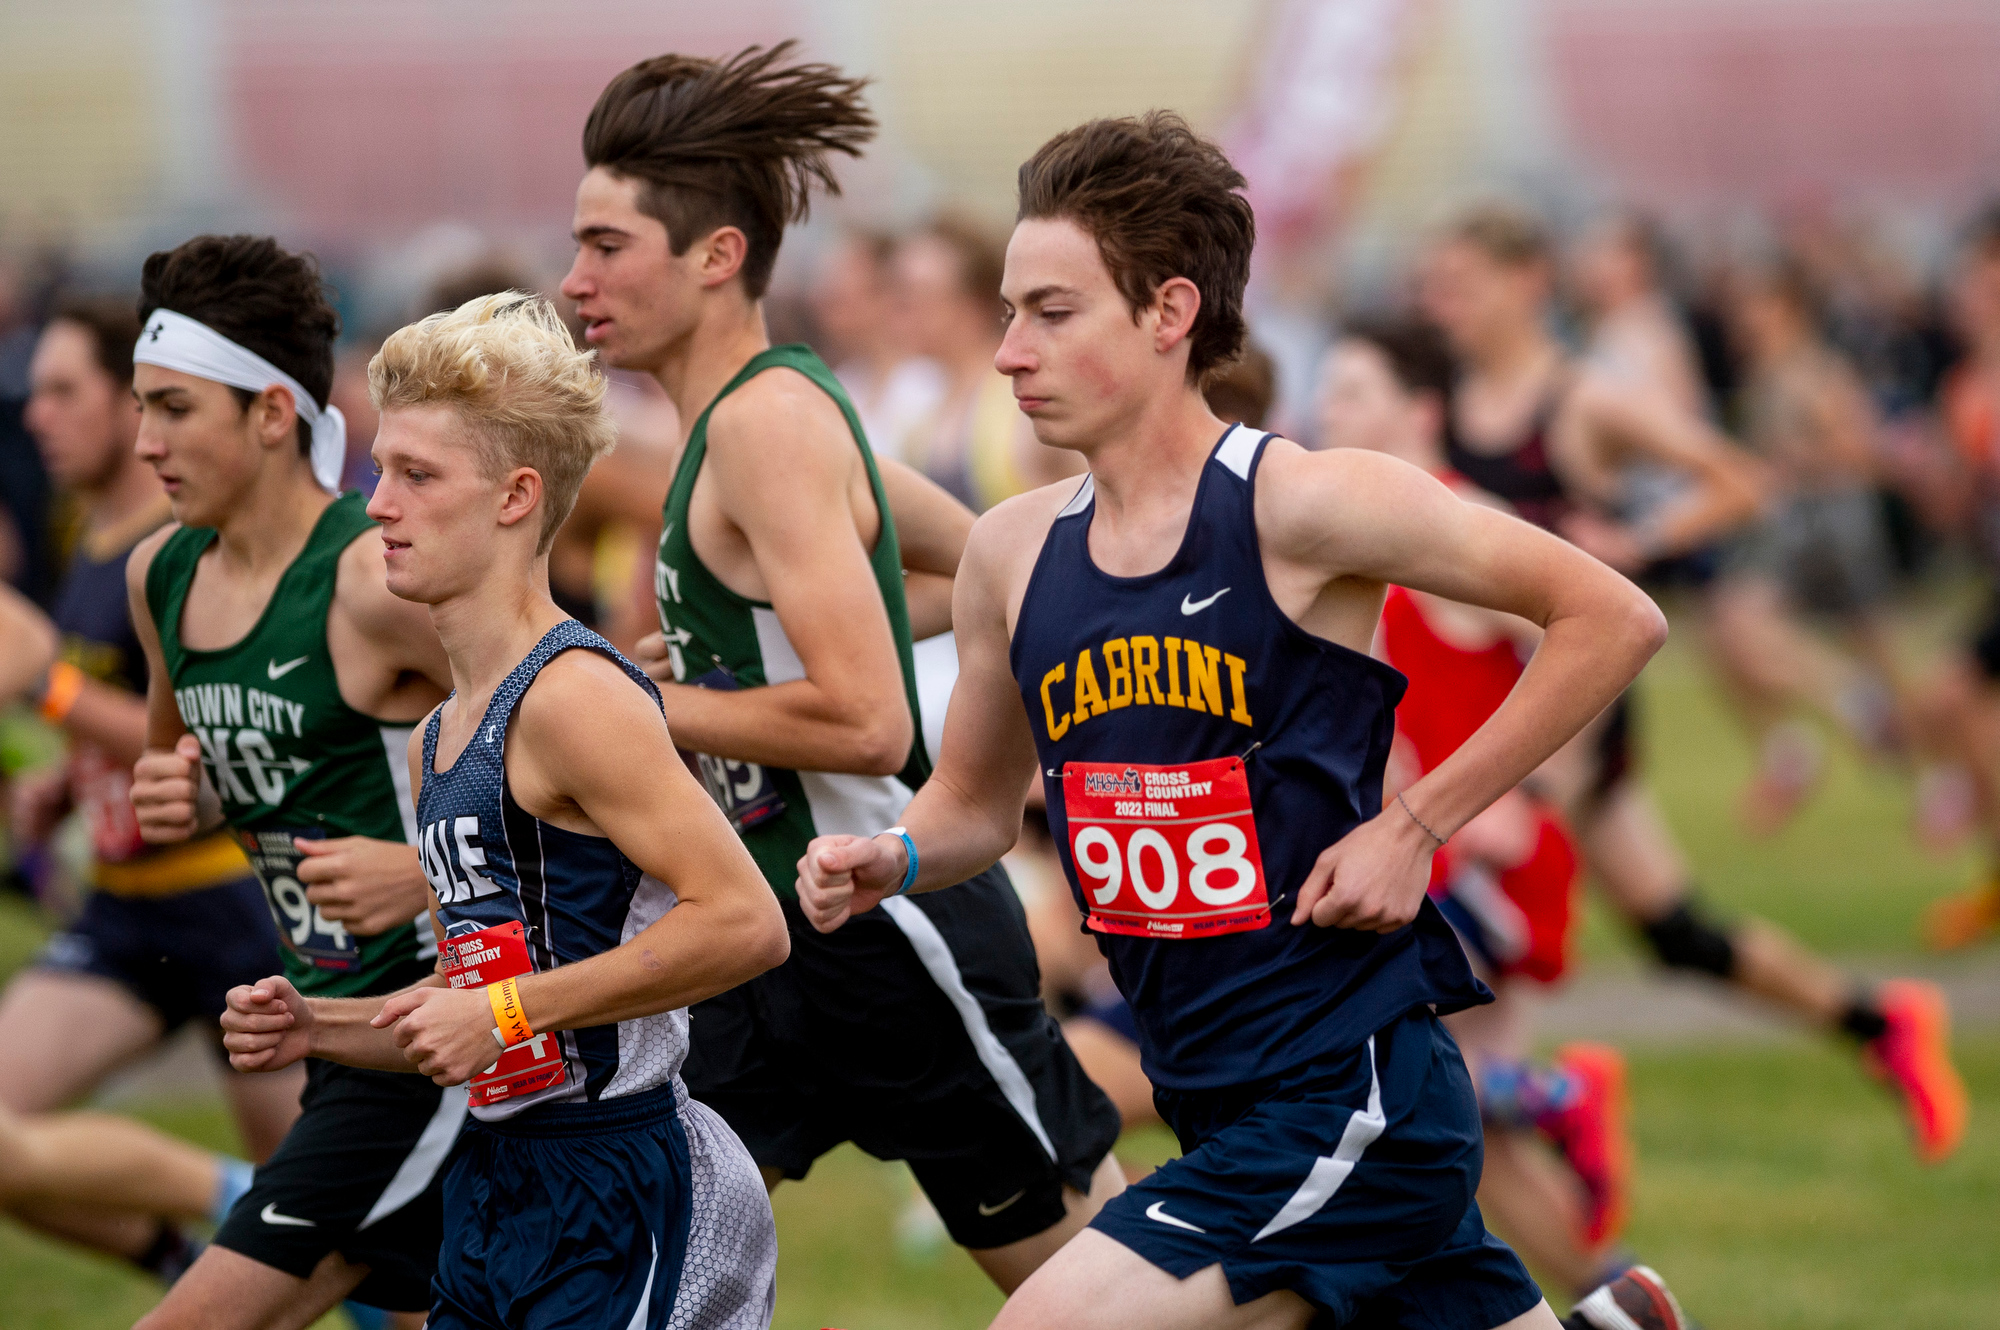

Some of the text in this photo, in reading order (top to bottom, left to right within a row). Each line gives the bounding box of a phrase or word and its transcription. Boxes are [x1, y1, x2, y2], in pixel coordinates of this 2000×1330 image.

[1040, 635, 1253, 742] CABRINI
[247, 686, 305, 739] CITY
[193, 727, 286, 806] XC
[1144, 771, 1191, 786] CROSS
[1145, 781, 1212, 799] COUNTRY
[1114, 801, 1179, 817] 2022 FINAL
[1074, 823, 1256, 910] 908
[458, 938, 485, 956] CROSS
[461, 946, 502, 968] COUNTRY
[449, 969, 484, 989] 2022 FINAL
[512, 1072, 553, 1089] WEAR ON FRONT
